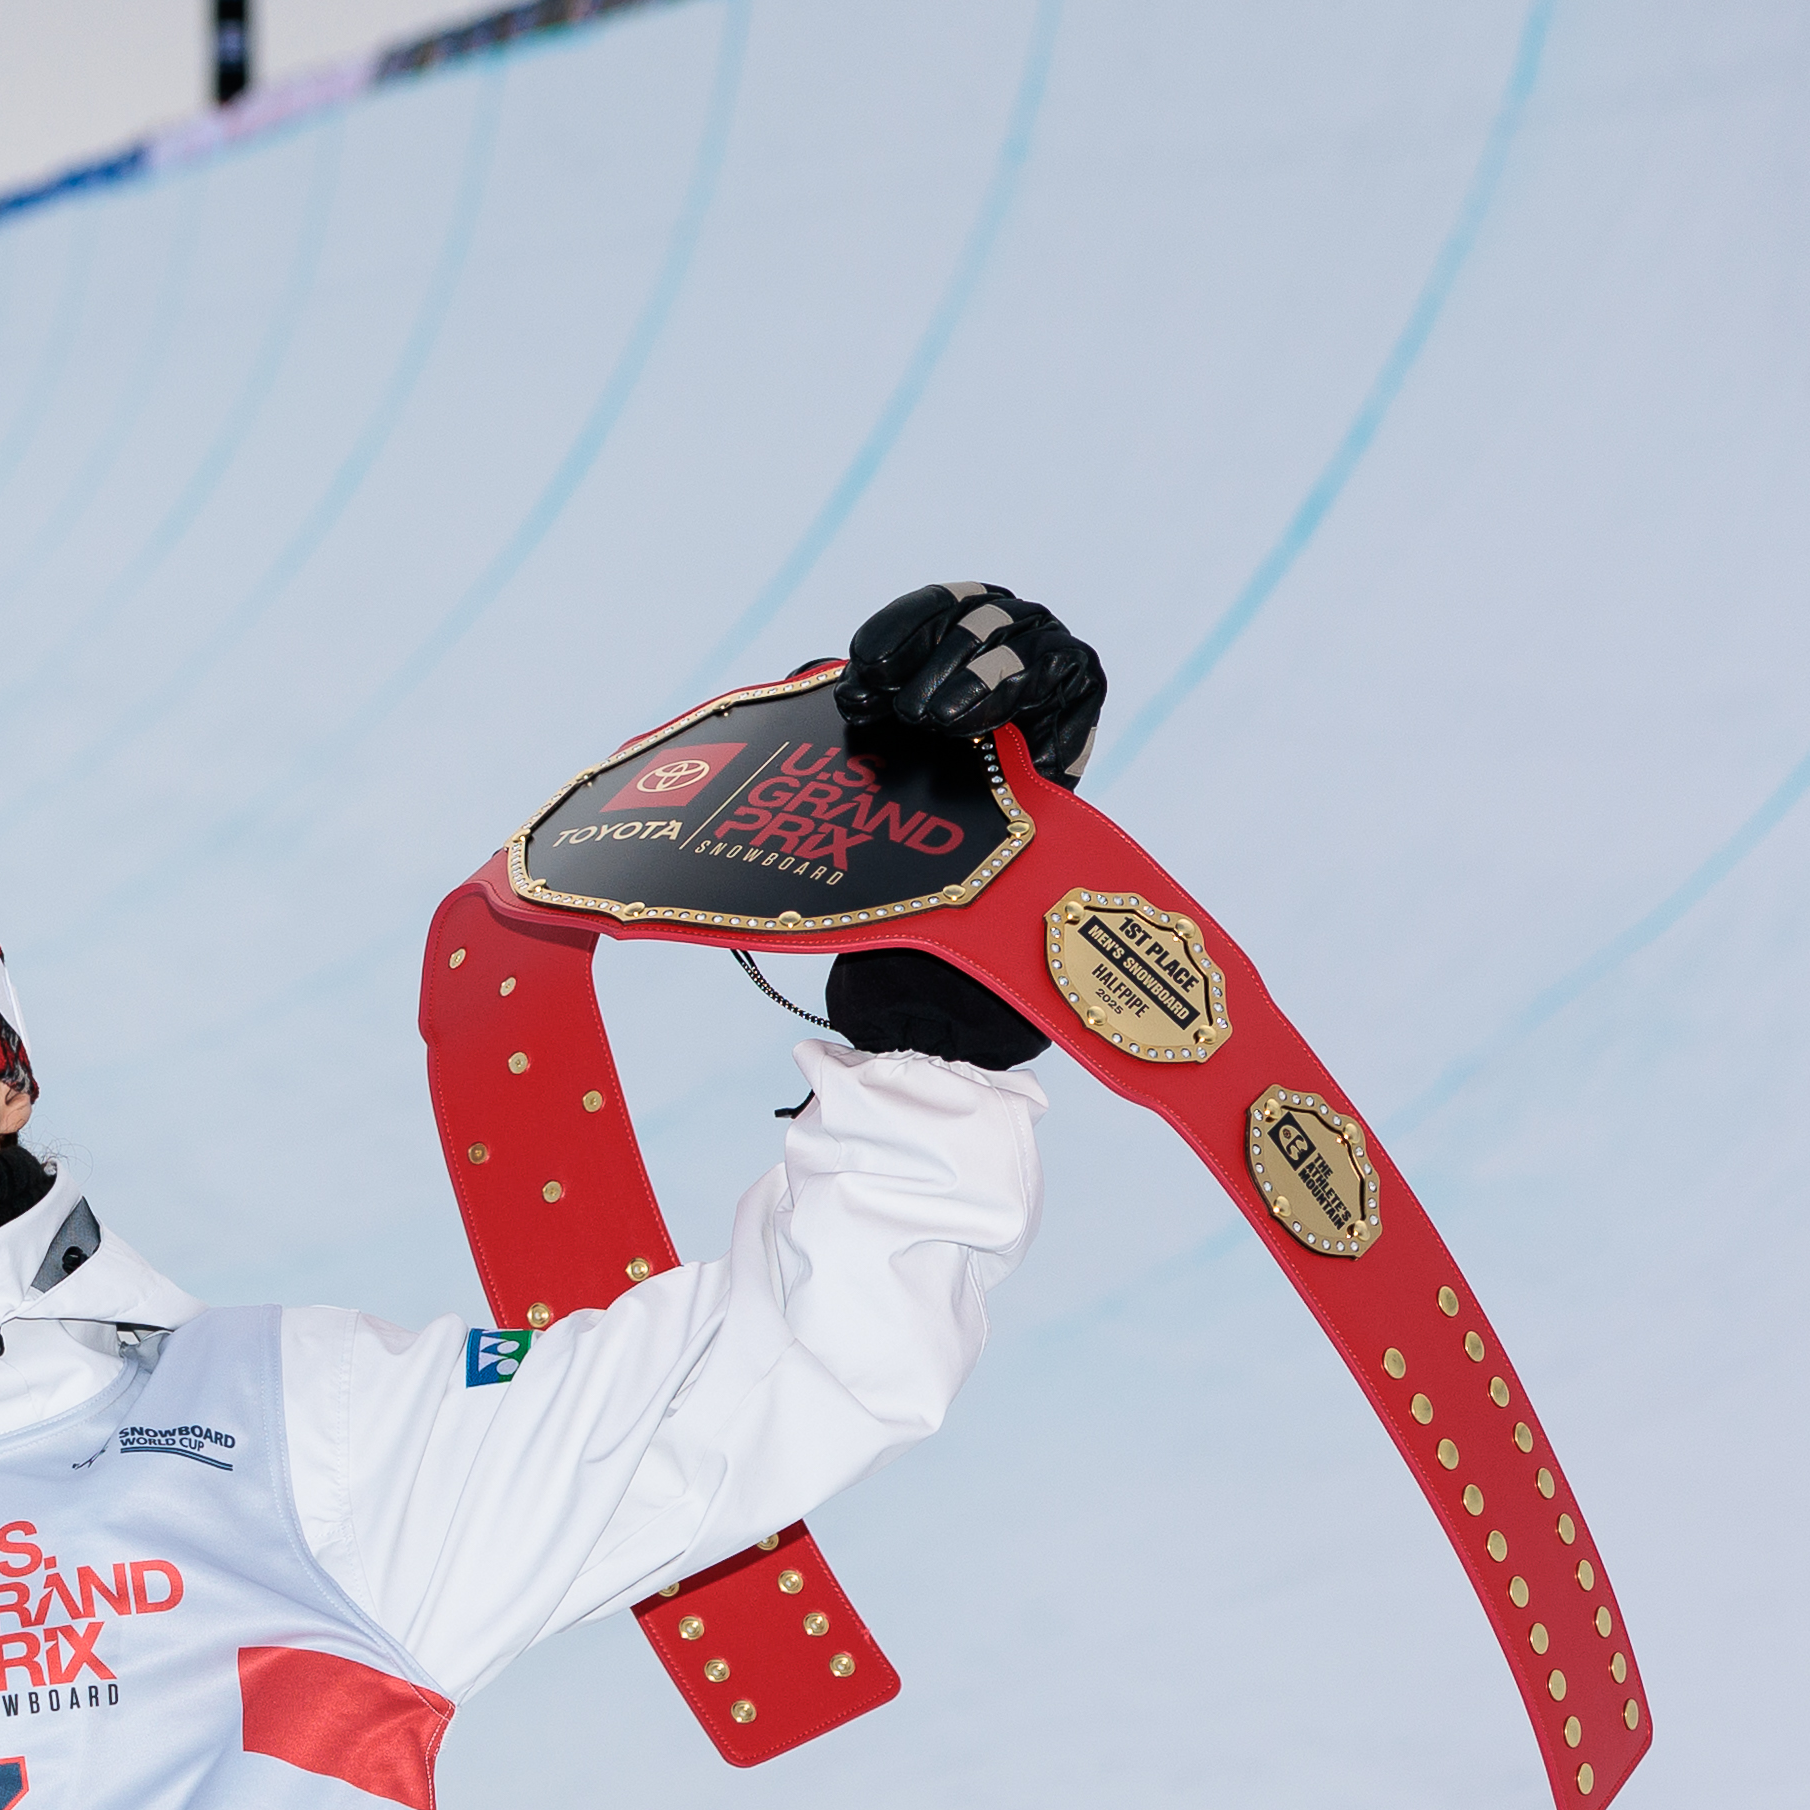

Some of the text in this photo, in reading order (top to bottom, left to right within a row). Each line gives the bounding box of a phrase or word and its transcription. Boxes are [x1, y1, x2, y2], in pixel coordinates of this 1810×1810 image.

[779, 742, 889, 792] U.S.
[552, 820, 683, 850] TOYOTA
[714, 806, 873, 871] PRIX
[746, 776, 964, 855] GRAND
[694, 840, 845, 886] SNOWBOARD
[1088, 924, 1189, 1020] MEN'S SNOWBOARD
[1118, 916, 1199, 993] 1ST PLACE
[1091, 963, 1150, 1018] HALFPIPE
[1095, 988, 1124, 1015] 2025
[1304, 1162, 1352, 1222] ATHLETE'S
[1312, 1153, 1334, 1179] THE
[1298, 1168, 1346, 1231] MOUNTAIN
[119, 1425, 236, 1449] SNOWBOARD
[120, 1437, 205, 1452] WORLD CUP
